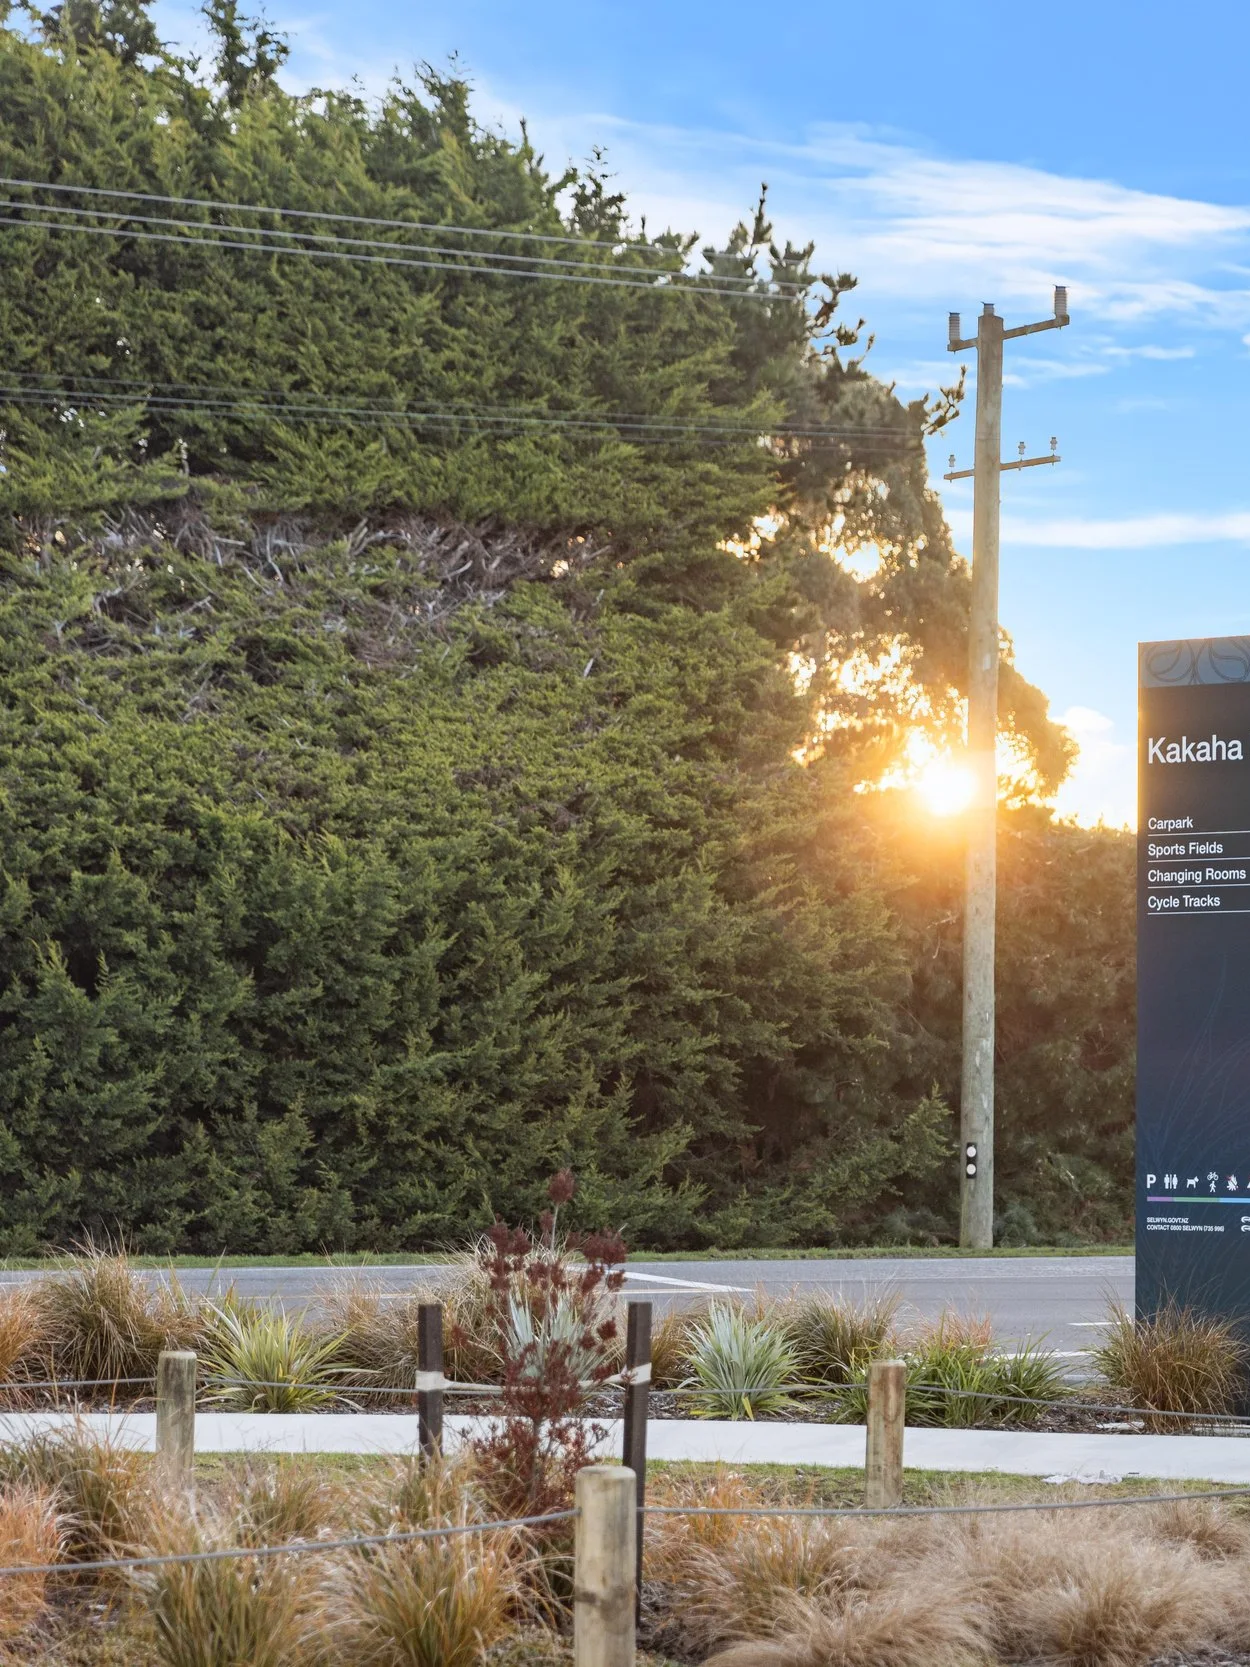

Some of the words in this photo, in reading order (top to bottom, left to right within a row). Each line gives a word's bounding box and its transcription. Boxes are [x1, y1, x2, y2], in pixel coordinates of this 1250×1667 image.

[1148, 734, 1243, 764] Kakaha
[1148, 816, 1193, 831] Carpark
[1148, 843, 1185, 858] Sports
[1189, 842, 1223, 854] Fields
[1148, 869, 1202, 883] Changing
[1205, 867, 1246, 880] Rooms
[1148, 895, 1180, 911] Cycle
[1183, 894, 1221, 907] Tracks
[1146, 1174, 1157, 1189] P
